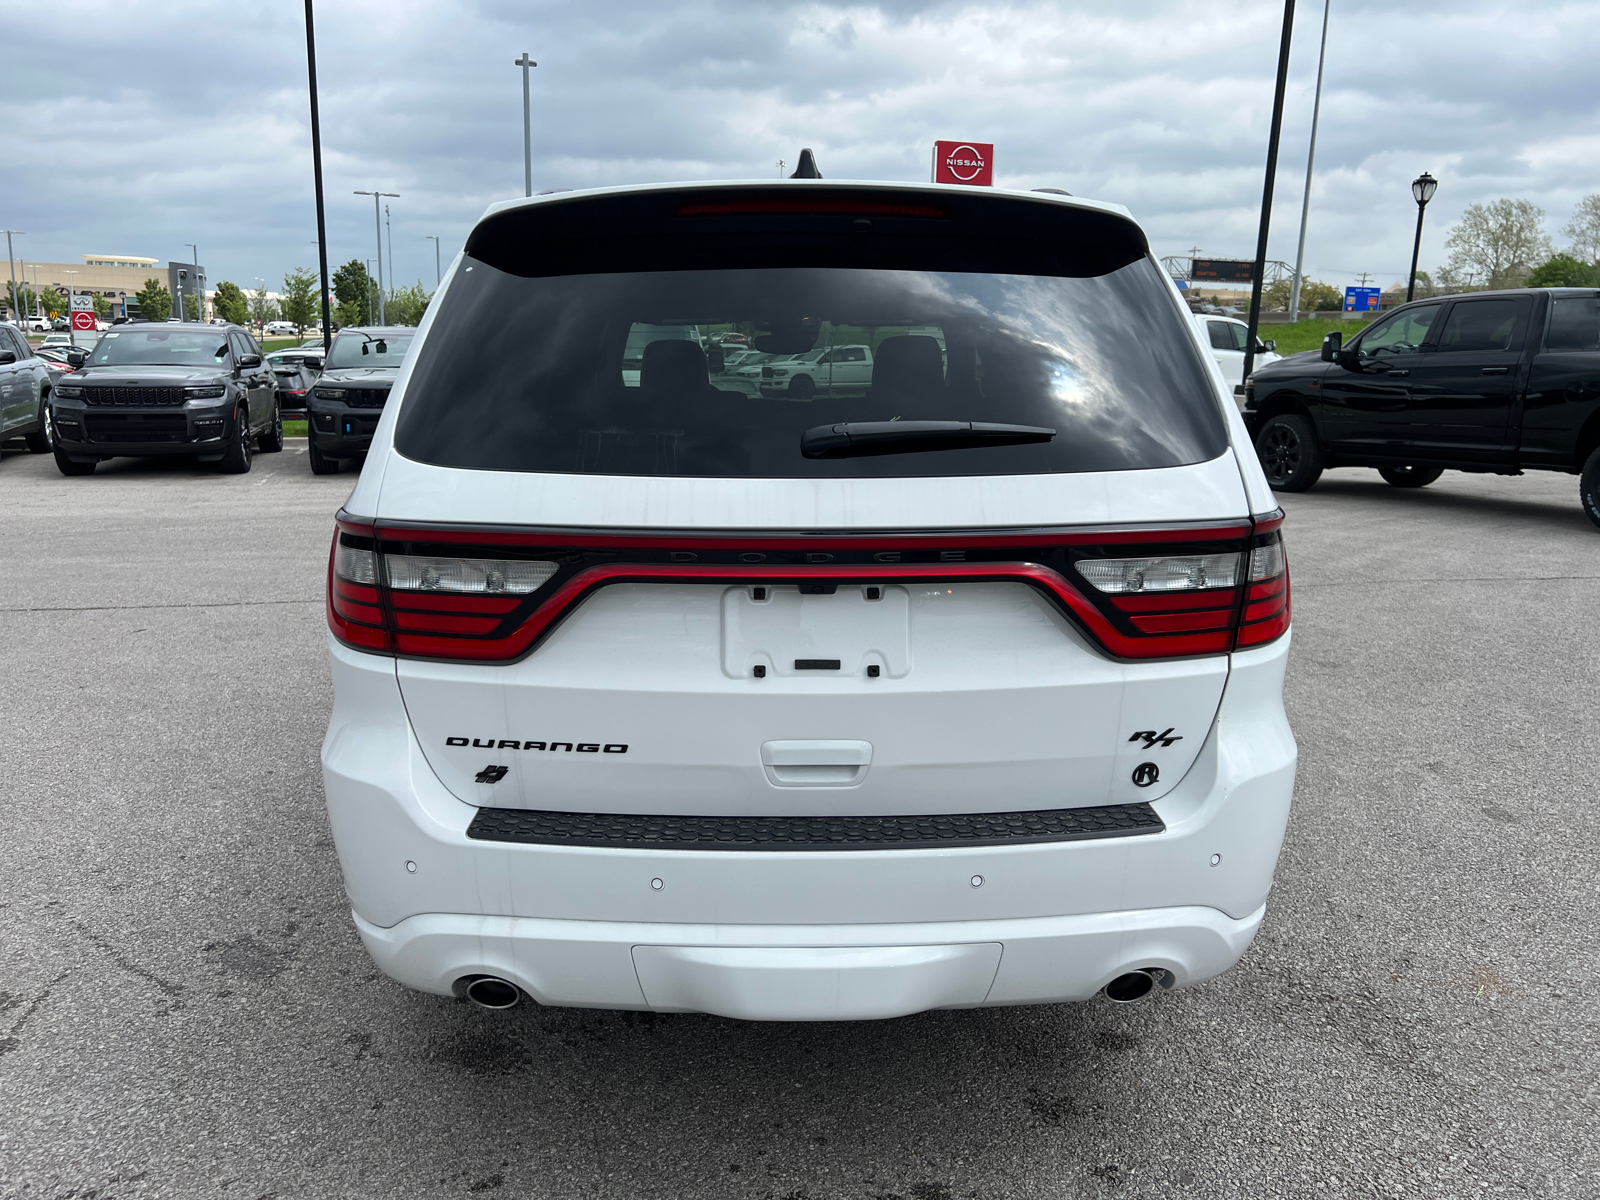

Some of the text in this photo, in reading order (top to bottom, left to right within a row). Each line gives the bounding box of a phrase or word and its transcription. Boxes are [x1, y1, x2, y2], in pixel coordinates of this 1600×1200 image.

[946, 158, 985, 167] NISSAN
[670, 551, 966, 563] DODGE
[445, 736, 629, 754] DURANGO
[1128, 727, 1184, 750] R/T
